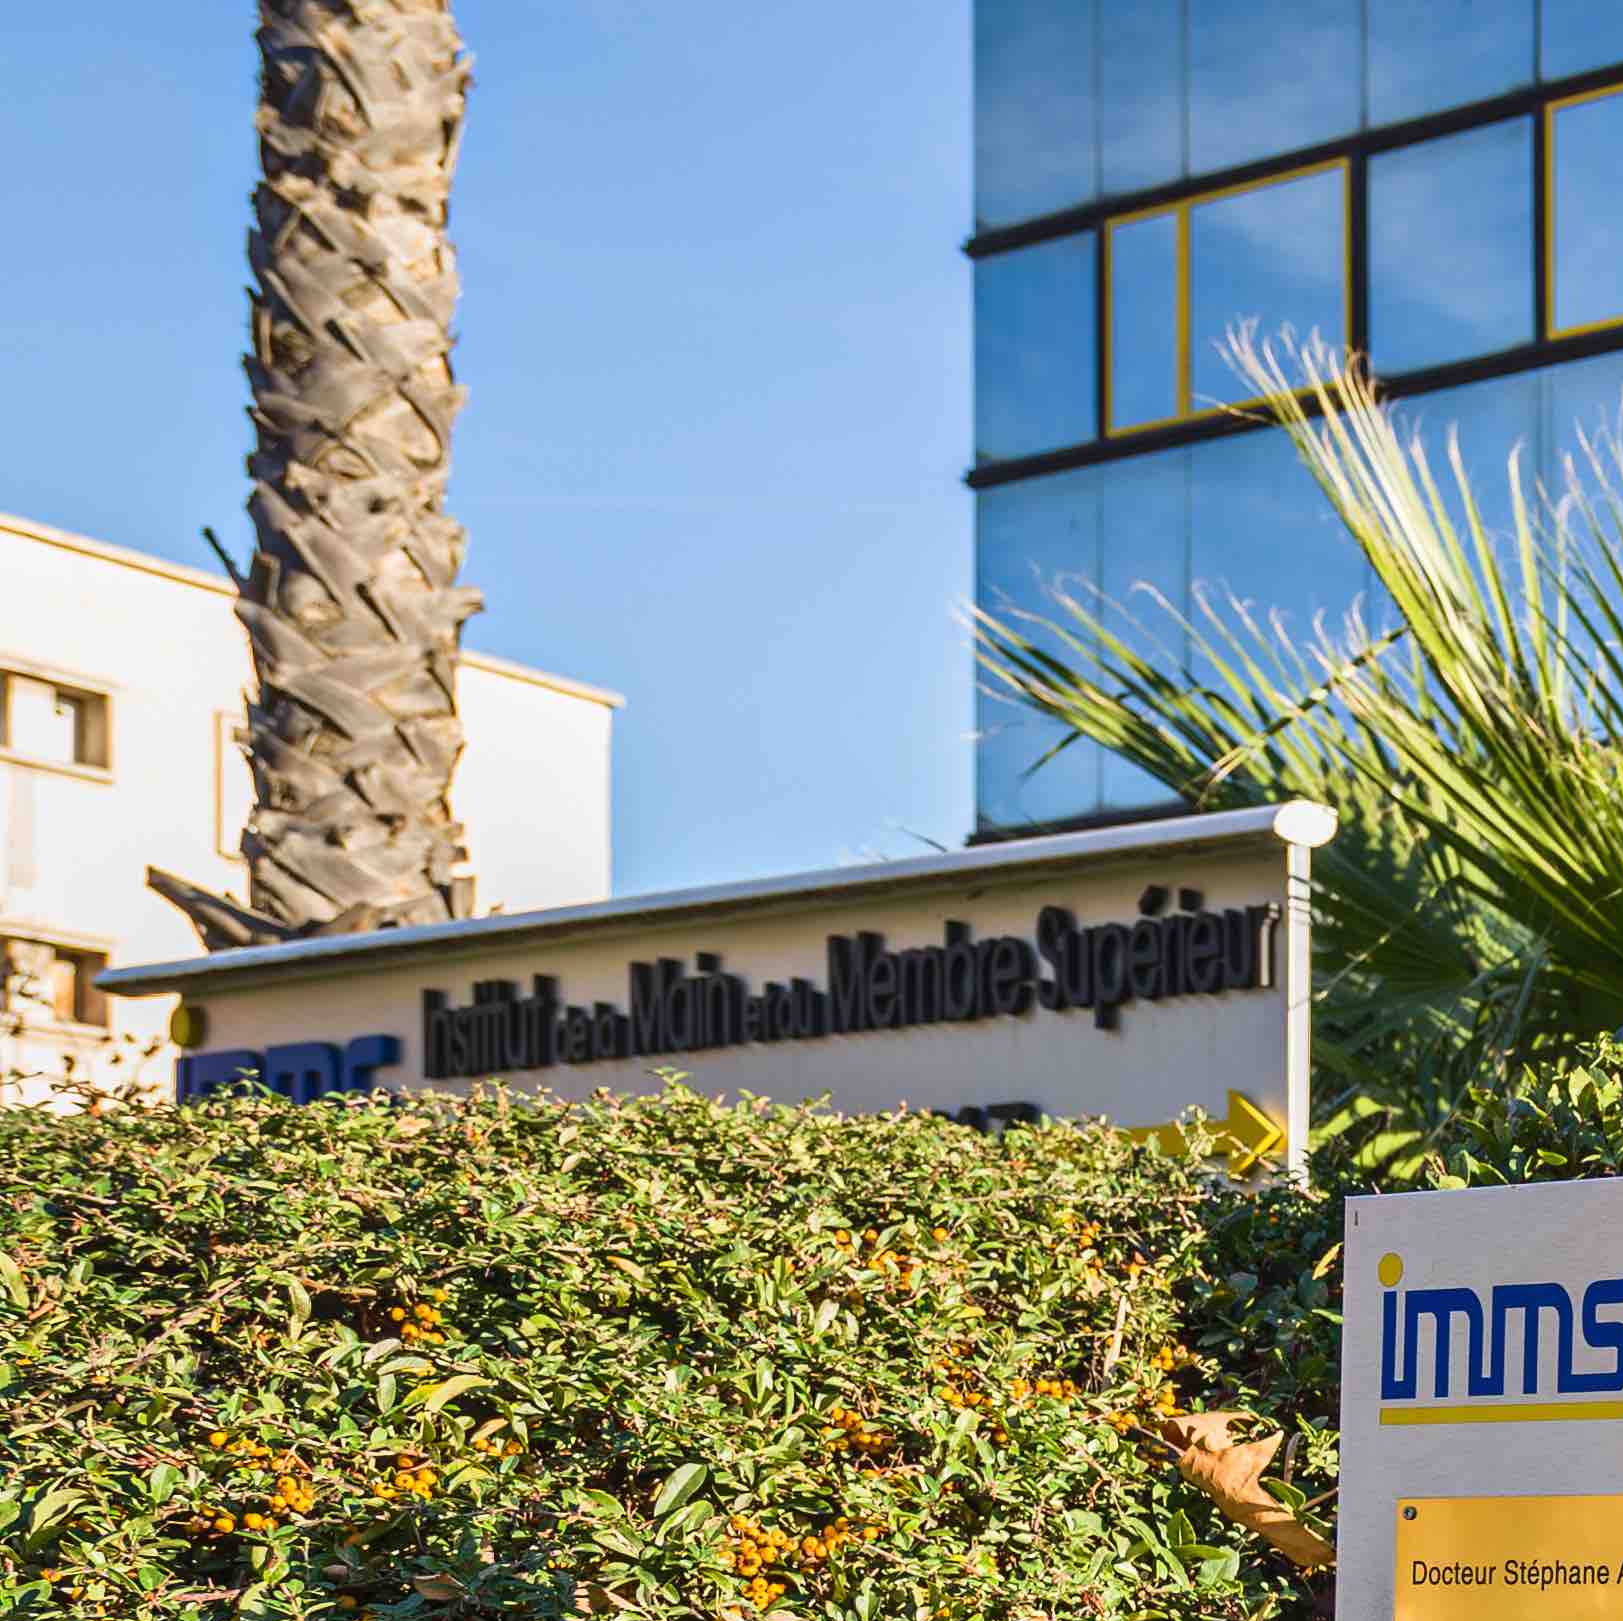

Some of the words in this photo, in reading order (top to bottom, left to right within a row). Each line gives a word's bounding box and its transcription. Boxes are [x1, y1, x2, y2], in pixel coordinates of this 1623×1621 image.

[422, 975, 561, 1079] Institut
[630, 954, 748, 1055] Main
[828, 919, 1036, 1032] Membre
[1035, 886, 1279, 1031] Supérieur
[1412, 1560, 1496, 1585] Docteur
[1504, 1559, 1609, 1591] Stéphane
